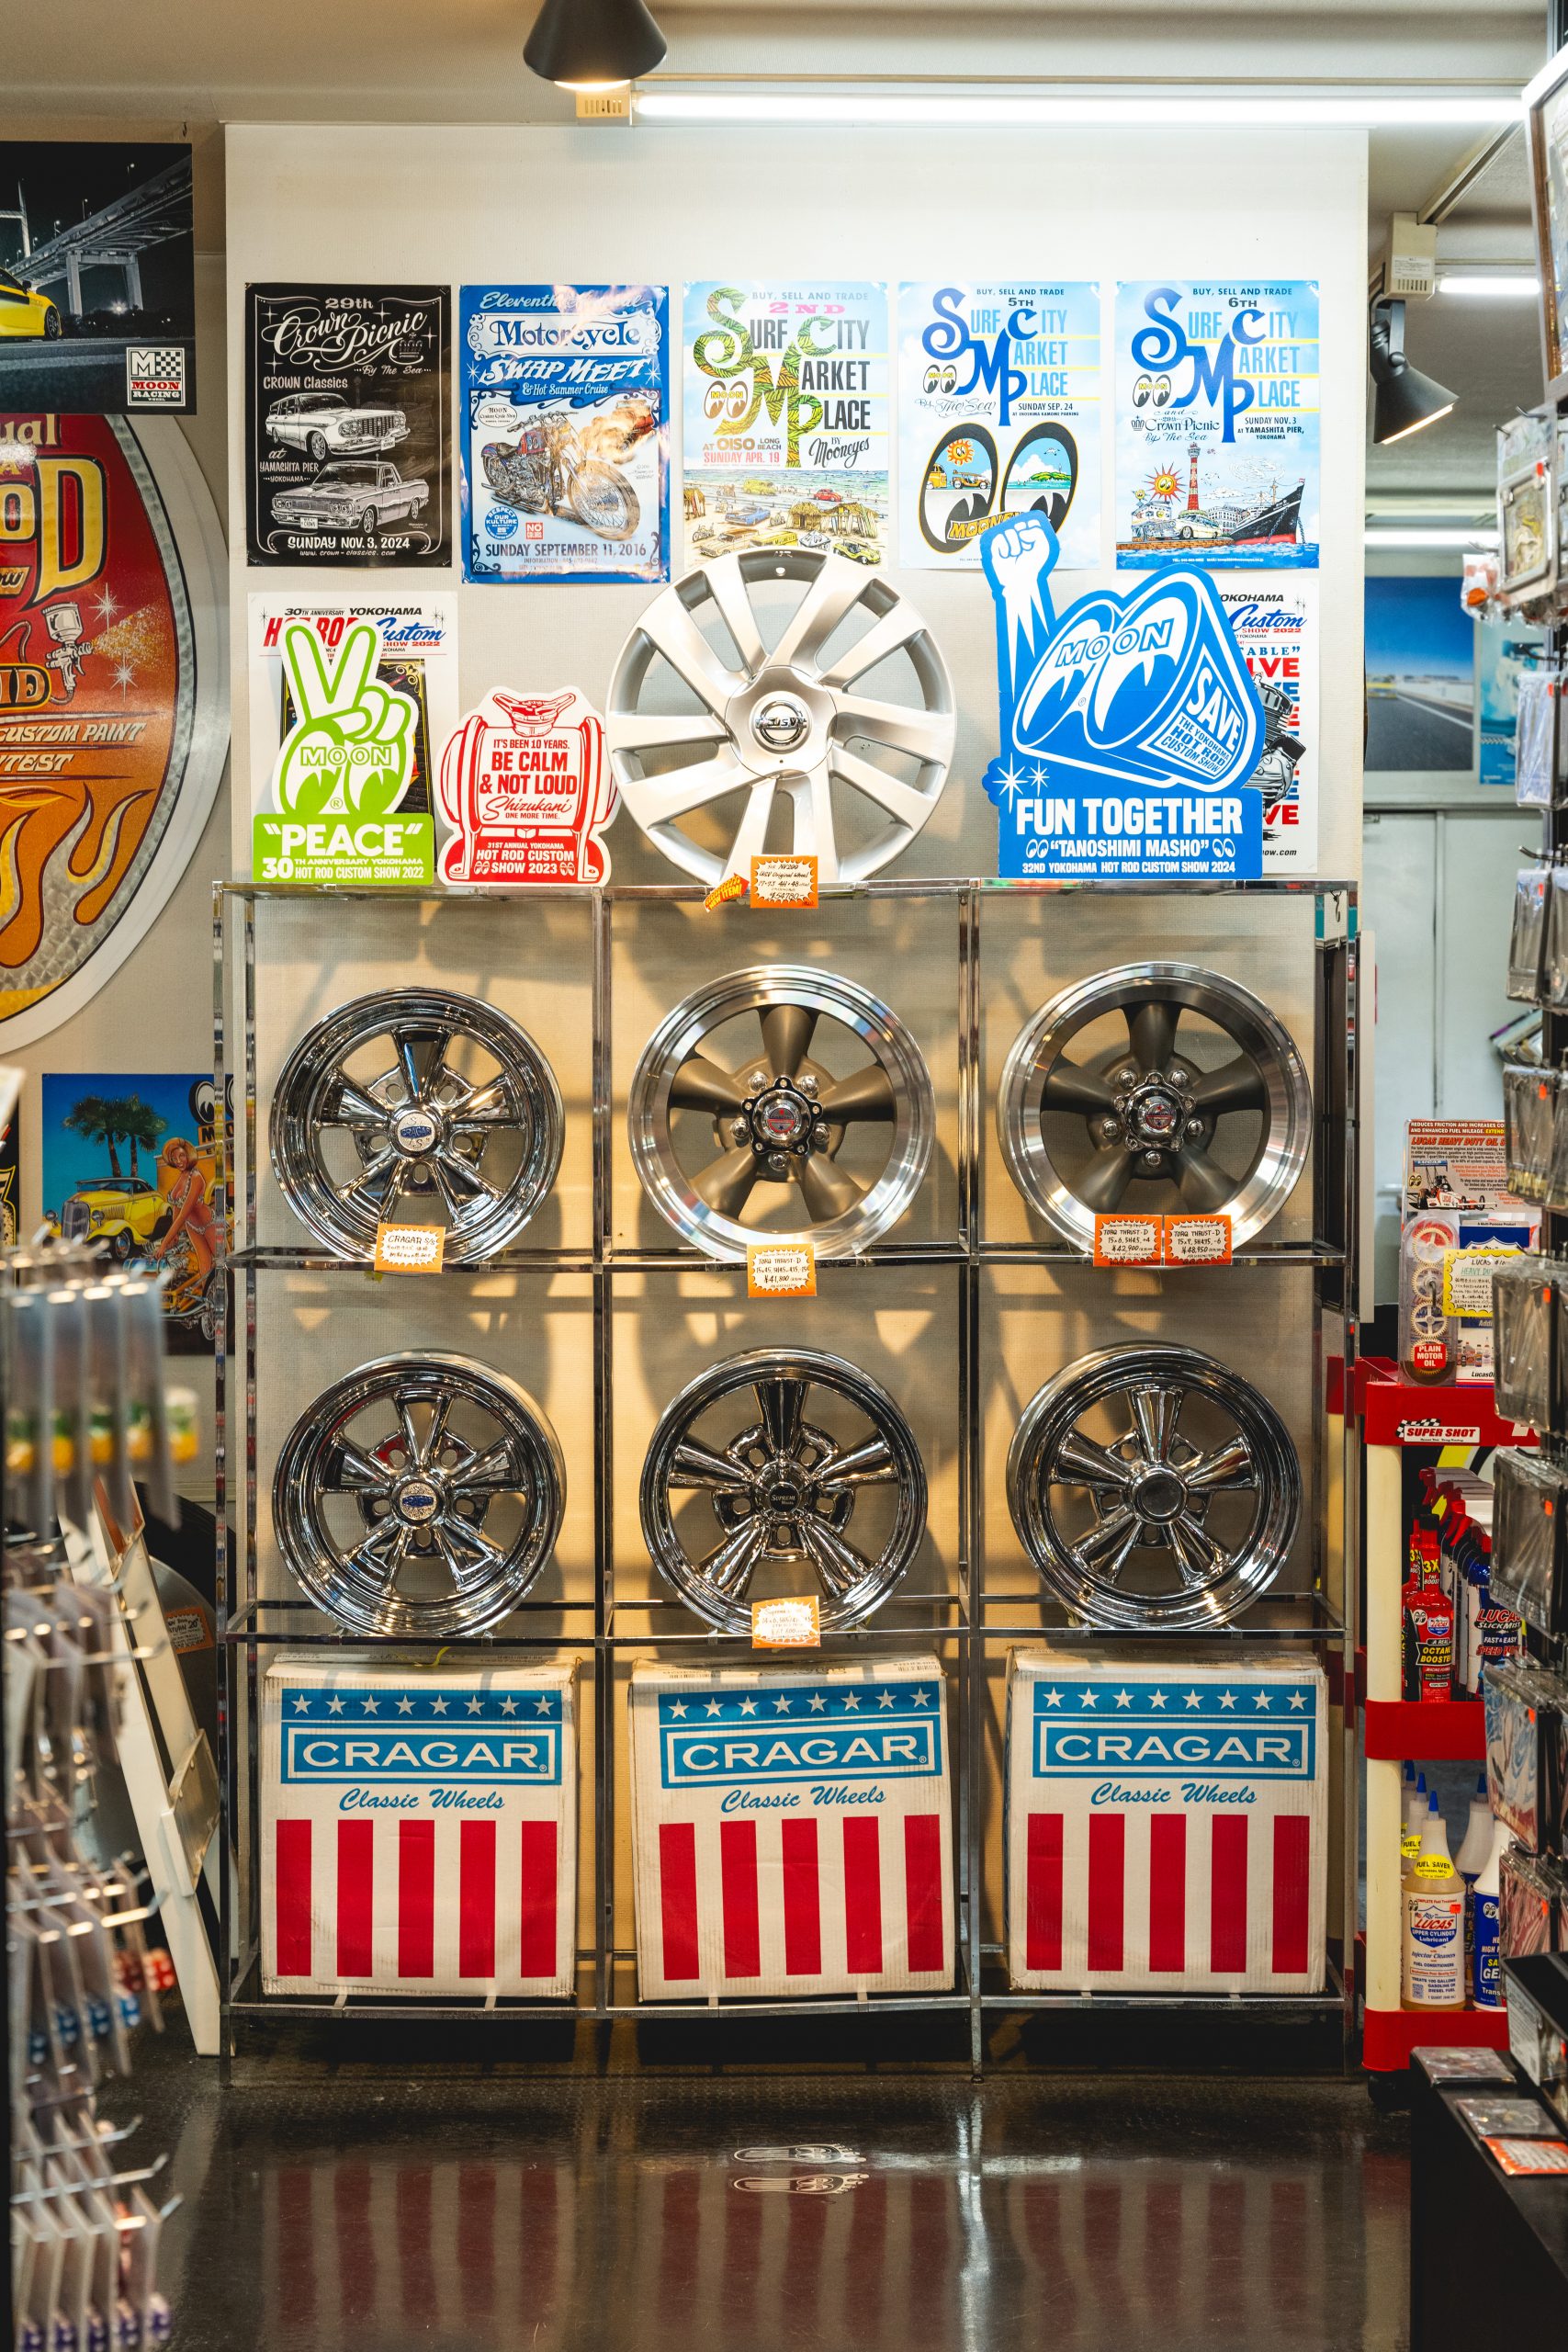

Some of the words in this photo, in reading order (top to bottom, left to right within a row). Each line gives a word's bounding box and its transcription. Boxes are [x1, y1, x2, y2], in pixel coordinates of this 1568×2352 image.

[752, 292, 778, 301] BUY,
[782, 292, 805, 300] SELL
[808, 292, 831, 300] AND
[835, 292, 869, 300] TRADE
[1192, 288, 1215, 297] BUY,
[1218, 288, 1237, 296] SELL
[1240, 288, 1260, 296] AND
[1264, 288, 1292, 296] TRADE
[325, 297, 374, 310] 29th
[769, 302, 846, 314] 2ND
[1008, 297, 1034, 307] 5TH
[1228, 297, 1258, 308] 6TH
[1008, 308, 1067, 341] CITY
[1232, 309, 1299, 345] CITY
[262, 306, 362, 356] Crown
[333, 311, 428, 363] Picnic
[490, 320, 641, 351] Motorcycle
[796, 315, 871, 356] CITY
[478, 357, 561, 387] SWAP
[558, 356, 652, 385] MEET
[131, 381, 180, 390] MOON
[263, 376, 300, 390] CROWN
[303, 377, 348, 389] Classics
[584, 384, 609, 395] Cruise
[1138, 382, 1168, 390] MOON
[710, 390, 744, 400] MOON
[1018, 402, 1046, 411] SUNDAY
[1047, 402, 1063, 411] SEP.
[1145, 418, 1181, 431] Crown
[1181, 417, 1220, 431] Picnic
[1245, 416, 1272, 425] SUNDAY
[1274, 416, 1291, 425] NOV.
[1245, 425, 1285, 434] YAMASHITA
[716, 437, 756, 450] OISO
[831, 436, 842, 445] BY
[267, 449, 288, 459] at
[704, 452, 744, 464] SUNDAY
[745, 452, 765, 464] APR.
[768, 451, 780, 463] 19
[808, 437, 870, 469] Mooneyes
[259, 461, 300, 473] YAMASHITA
[302, 462, 320, 473] PIER
[270, 475, 304, 483] YOKOHAMA
[526, 524, 542, 532] NO
[288, 536, 336, 549] SUNDAY
[341, 537, 365, 548] NOV.
[380, 537, 411, 548] 2024
[485, 544, 530, 557] SUNDAY
[535, 544, 597, 557] SEPTEMBER
[618, 544, 647, 557] 2016
[349, 607, 423, 616] YOKOHAMA
[1228, 603, 1308, 632] Custom
[1055, 618, 1175, 668] MOON
[1185, 666, 1242, 752] SAVE
[1169, 725, 1202, 749] HOT
[493, 739, 508, 749] IT'S
[509, 739, 529, 749] BEEN
[531, 740, 542, 749] 10
[544, 740, 570, 750] YEARS.
[299, 746, 392, 767] MOON
[491, 752, 513, 772] BE
[518, 752, 568, 772] CALM
[479, 774, 493, 795] &
[497, 775, 531, 795] NOT
[535, 775, 578, 796] LOUD
[482, 795, 572, 821] Shizukani
[1016, 797, 1077, 835] FUN
[1082, 797, 1243, 835] TOGETHER
[476, 850, 498, 860] HOT
[501, 850, 525, 861] ROD
[527, 850, 574, 862] CUSTOM
[295, 866, 313, 879] HOT
[315, 866, 334, 879] ROD
[335, 866, 372, 879] CUSTOM
[373, 866, 400, 879] SHOW
[401, 866, 424, 878] 2022
[491, 863, 526, 874] SHOW
[529, 863, 558, 874] 2023
[1021, 862, 1046, 874] 32ND
[1048, 862, 1098, 874] YOKOHAMA
[1100, 861, 1120, 874] HOT
[1121, 861, 1140, 874] ROD
[1141, 861, 1181, 874] CUSTOM
[1181, 861, 1210, 873] SHOW
[1211, 861, 1236, 873] 2024
[1411, 1136, 1438, 1146] LUCAS
[1438, 1137, 1463, 1146] HEAVY
[1463, 1137, 1485, 1146] DUTY
[388, 1235, 423, 1244] CRAGAR
[1407, 1428, 1443, 1437] SUPER
[1445, 1429, 1476, 1438] SHOT
[1476, 1645, 1503, 1656] SPEED
[302, 1741, 538, 1768] CRAGAR
[682, 1736, 919, 1770] CRAGAR
[1055, 1735, 1292, 1762] CRAGAR
[720, 1789, 801, 1814] Classic
[809, 1785, 886, 1806] Wheels
[1090, 1781, 1171, 1805] Classic
[1180, 1782, 1258, 1804] Wheels
[339, 1788, 420, 1812] Classic
[428, 1788, 505, 1811] Wheels
[1432, 1861, 1450, 1870] SAVER
[1415, 1918, 1454, 1930] LUCAS
